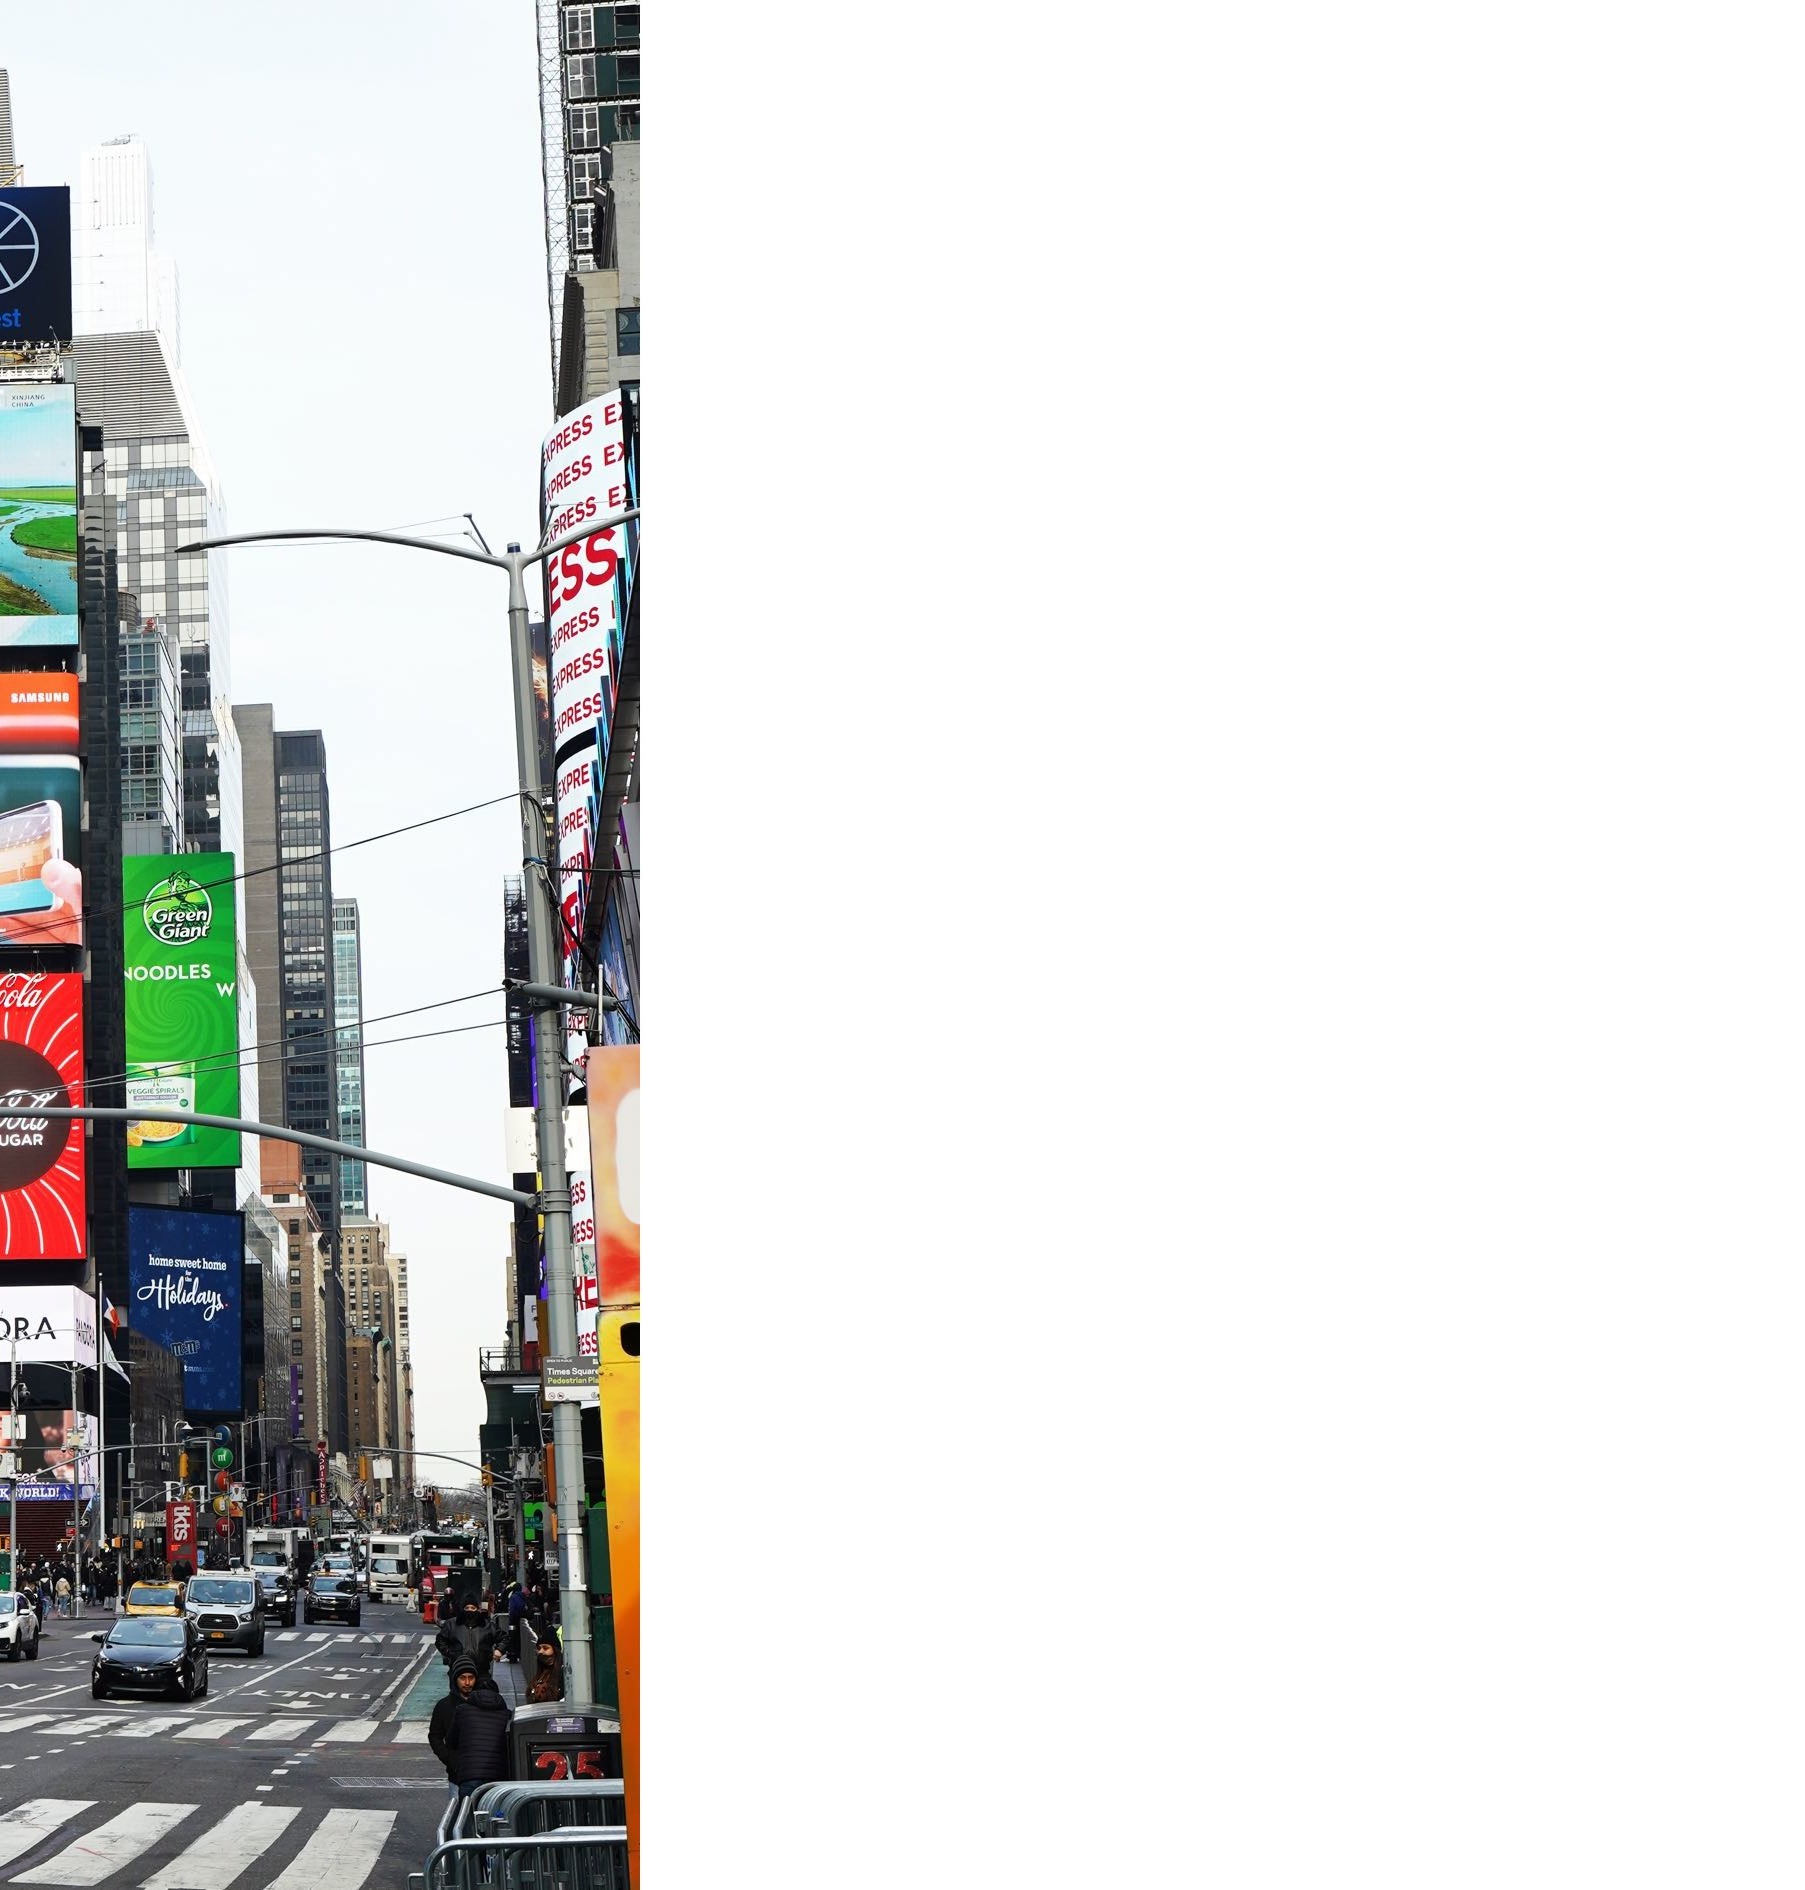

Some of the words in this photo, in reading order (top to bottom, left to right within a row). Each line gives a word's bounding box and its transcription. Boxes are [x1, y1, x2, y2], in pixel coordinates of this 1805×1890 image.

[10, 692, 70, 704] SAMSUNG
[152, 908, 208, 925] Green
[159, 923, 212, 940] Giant
[124, 964, 212, 982] NOODLES
[149, 1254, 174, 1267] home
[175, 1258, 202, 1269] sweet
[203, 1258, 227, 1271] home
[137, 1274, 225, 1321] Holidays
[173, 1505, 191, 1542] tkts
